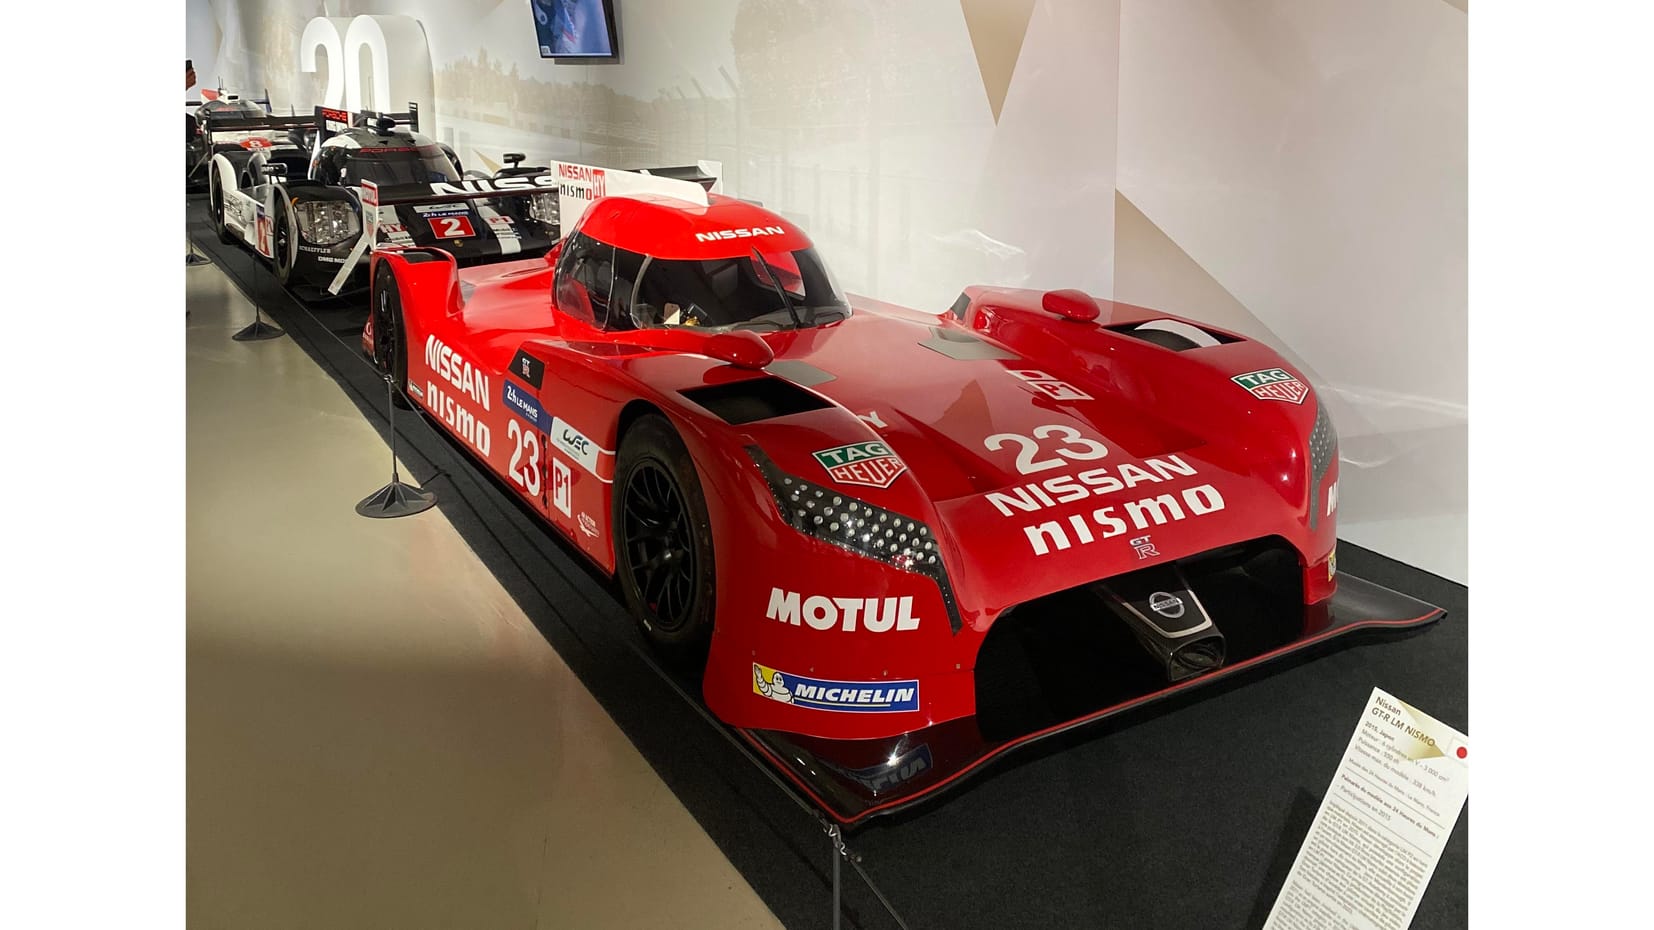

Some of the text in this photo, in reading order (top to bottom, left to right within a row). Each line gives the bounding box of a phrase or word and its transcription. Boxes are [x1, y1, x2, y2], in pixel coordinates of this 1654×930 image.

[301, 15, 389, 112] 20
[559, 164, 592, 182] NISSAN
[560, 184, 592, 200] nismo
[440, 218, 465, 236] 2
[696, 226, 784, 242] NISSAN
[425, 334, 490, 411] NISSAN
[1239, 370, 1290, 385] TAG
[1255, 381, 1304, 400] HEUER
[427, 381, 490, 457] nismo
[563, 429, 589, 455] WEC
[822, 442, 891, 464] TAG
[984, 425, 1108, 475] 23
[508, 419, 541, 496] 23
[834, 457, 903, 484] HEUER
[555, 467, 569, 508] P1
[984, 455, 1198, 517] NISSAN
[1023, 484, 1225, 556] nismo
[1130, 535, 1151, 546] GT
[1135, 543, 1160, 560] R
[766, 587, 920, 632] MOTUL
[795, 684, 915, 703] MICHELIN
[1376, 696, 1401, 716] Nissan
[1372, 705, 1435, 748] GT-R LM NISMO
